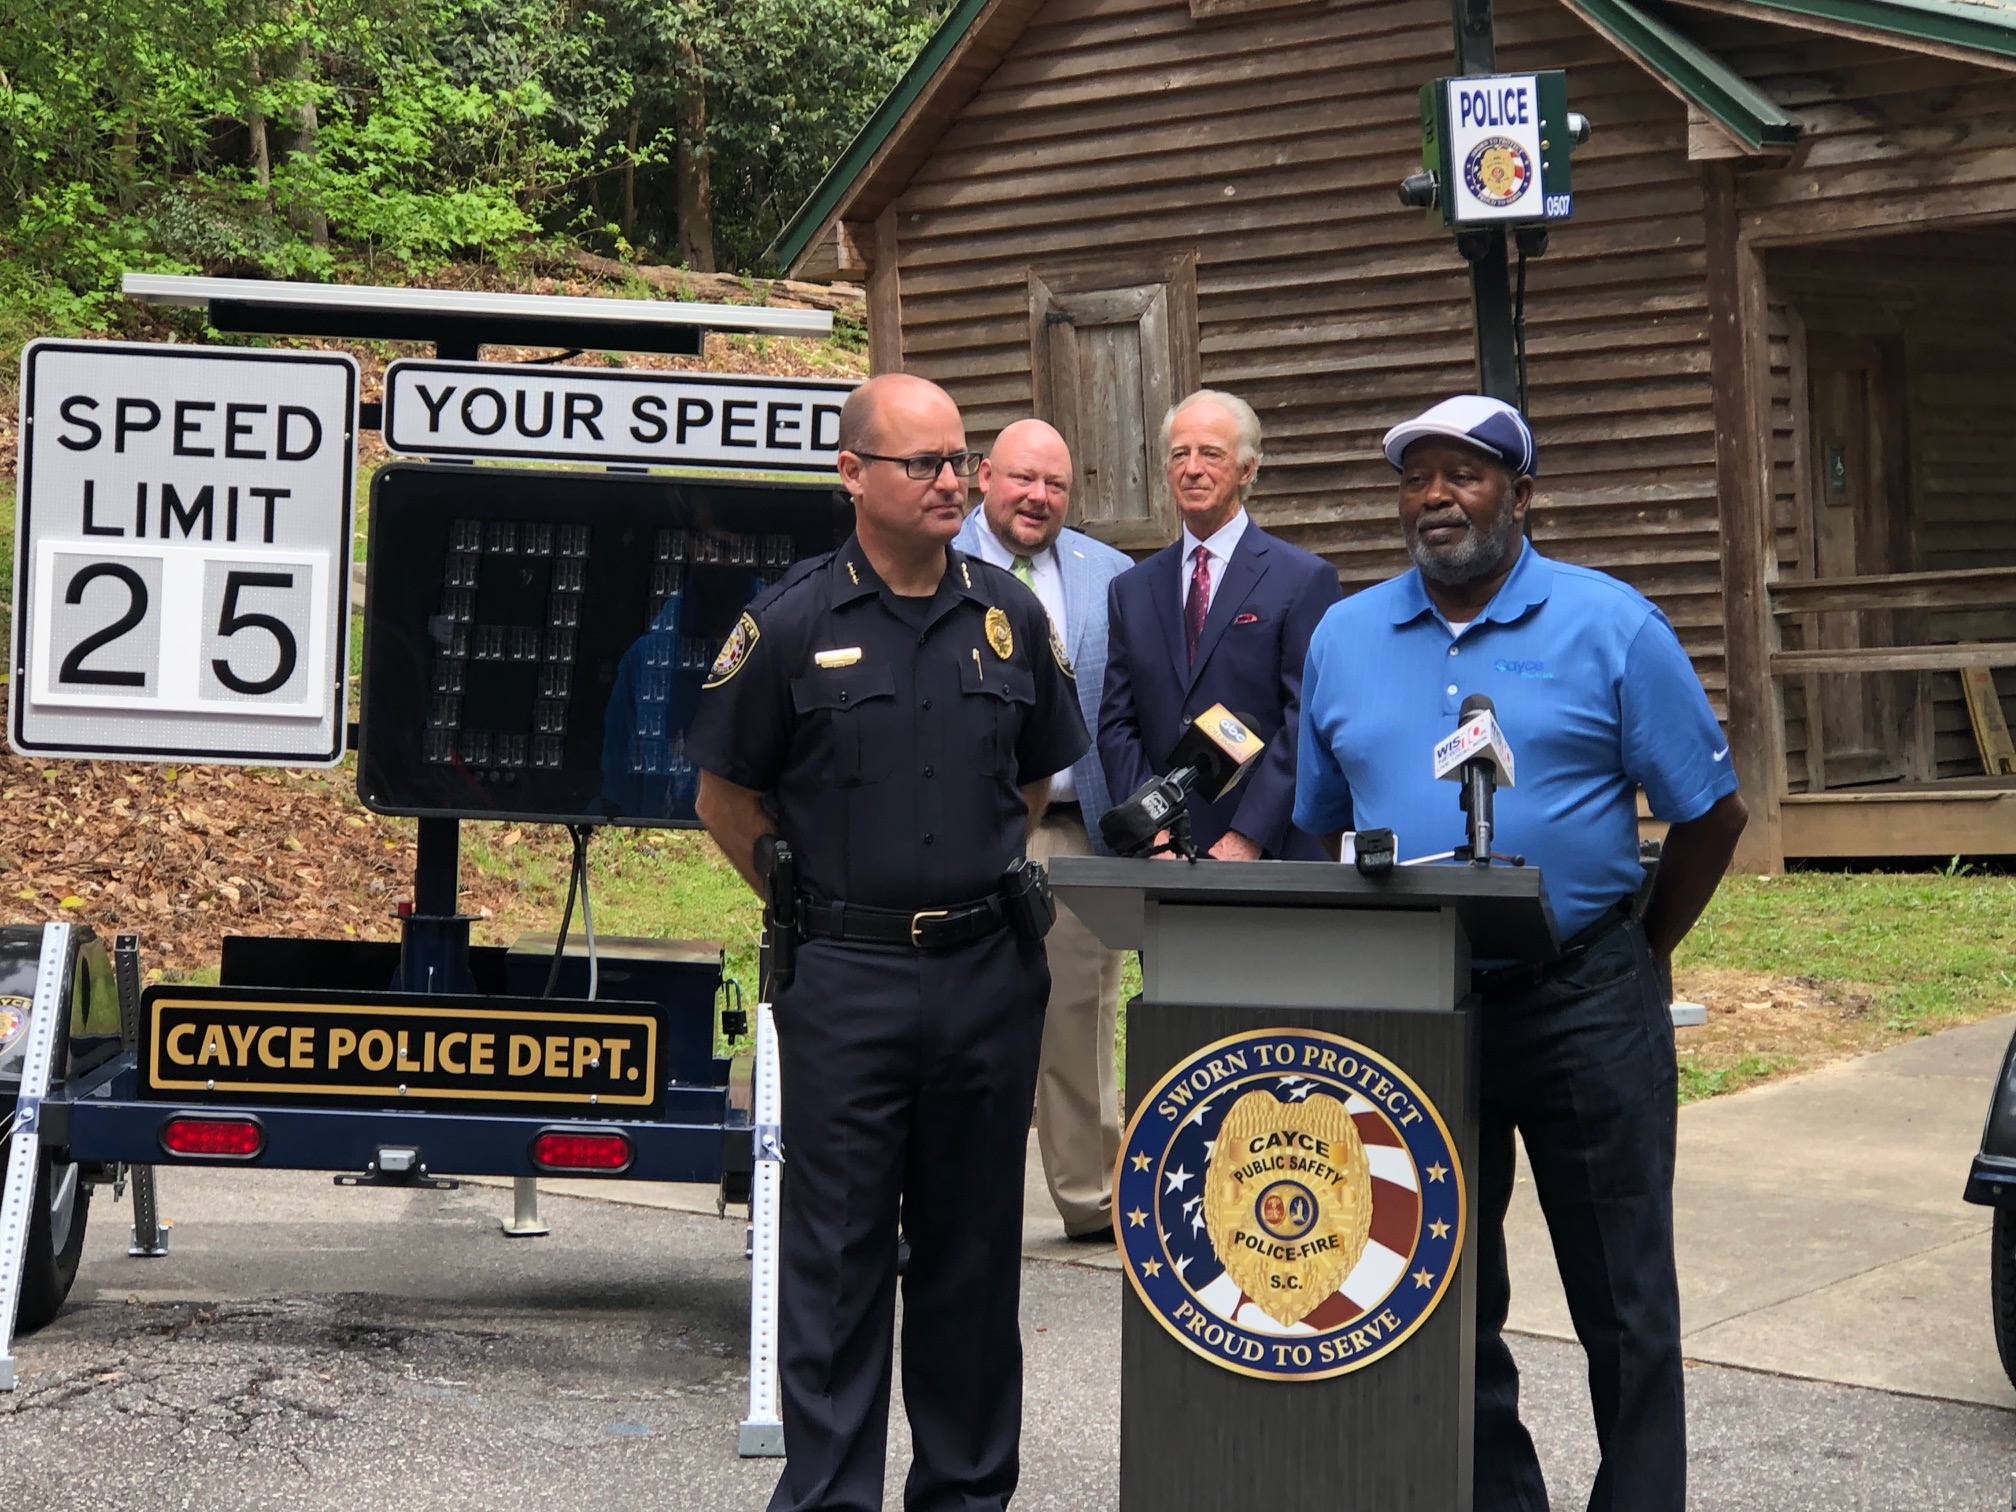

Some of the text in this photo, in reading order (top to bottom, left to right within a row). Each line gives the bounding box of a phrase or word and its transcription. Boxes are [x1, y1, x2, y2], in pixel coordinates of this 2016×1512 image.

[1460, 87, 1529, 128] POLICE
[1546, 195, 1570, 216] 0507
[57, 394, 322, 461] SPEED
[415, 384, 841, 451] YOUR SPEED
[82, 479, 291, 543] LIMIT
[58, 562, 297, 694] 25
[1202, 720, 1242, 758] COLUMBIA
[1221, 719, 1246, 742] abc
[1437, 736, 1461, 758] WIS
[0, 998, 32, 1010] YCE
[166, 1022, 640, 1081] CAYCE POLICE DEPT.
[1158, 1043, 1424, 1128] SWORN TO PROTECT
[1249, 1130, 1330, 1159] CAYCE
[1233, 1155, 1344, 1187] PUBLIC SAFETY
[1234, 1231, 1340, 1262] POLICE-FIRE
[1270, 1274, 1303, 1290] S.C.
[1172, 1299, 1402, 1366] PROUD TO SERVE
